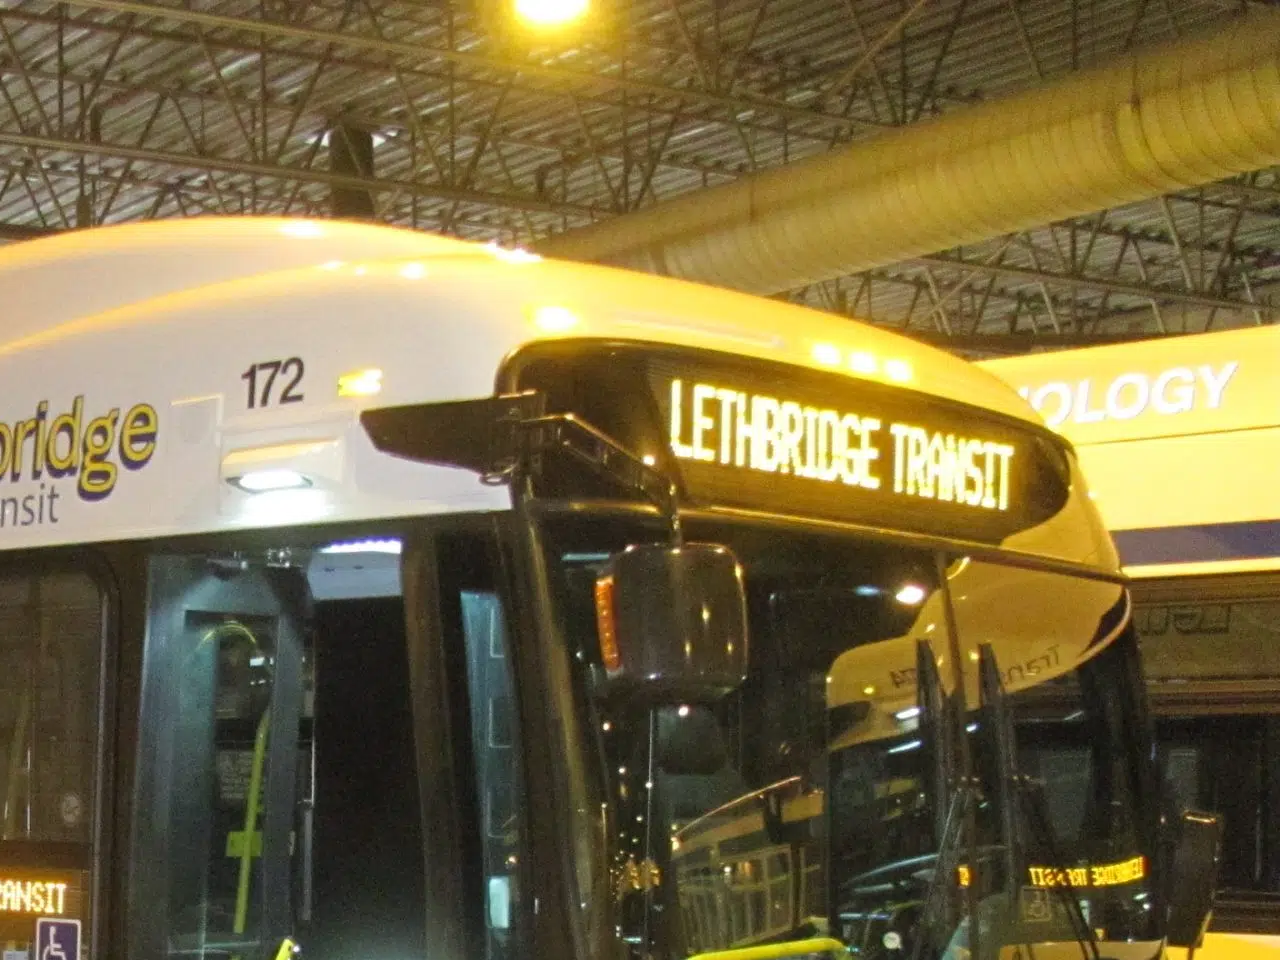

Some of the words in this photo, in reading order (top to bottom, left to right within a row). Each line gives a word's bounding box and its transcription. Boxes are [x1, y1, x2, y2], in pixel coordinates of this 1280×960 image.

[241, 357, 305, 409] 172
[1018, 360, 1239, 427] OLOGY
[669, 379, 881, 490] LETHBRIDGE
[889, 423, 1015, 511] TRANSIT
